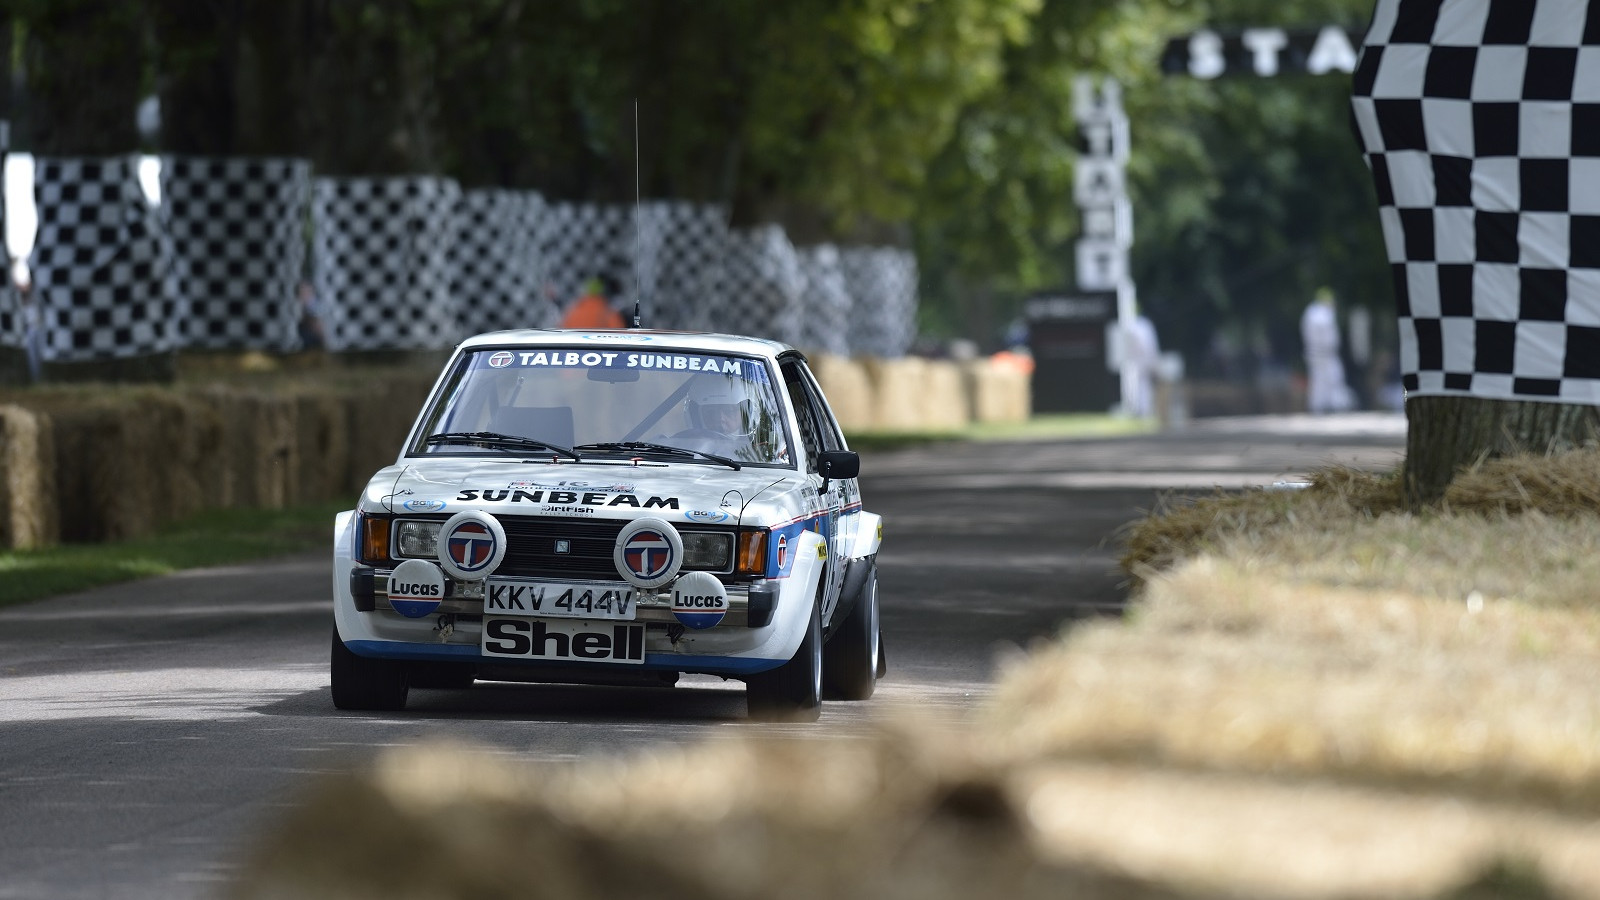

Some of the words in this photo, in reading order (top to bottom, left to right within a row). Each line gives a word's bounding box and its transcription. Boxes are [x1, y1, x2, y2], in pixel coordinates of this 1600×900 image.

[519, 352, 619, 367] TALBOT
[627, 354, 742, 375] SUNBEAM
[456, 489, 680, 510] SUNBEAM
[391, 578, 439, 596] Lucas
[488, 585, 546, 610] KKV
[554, 588, 632, 614] 444V
[674, 591, 723, 608] Lucas
[485, 619, 644, 660] Shell
